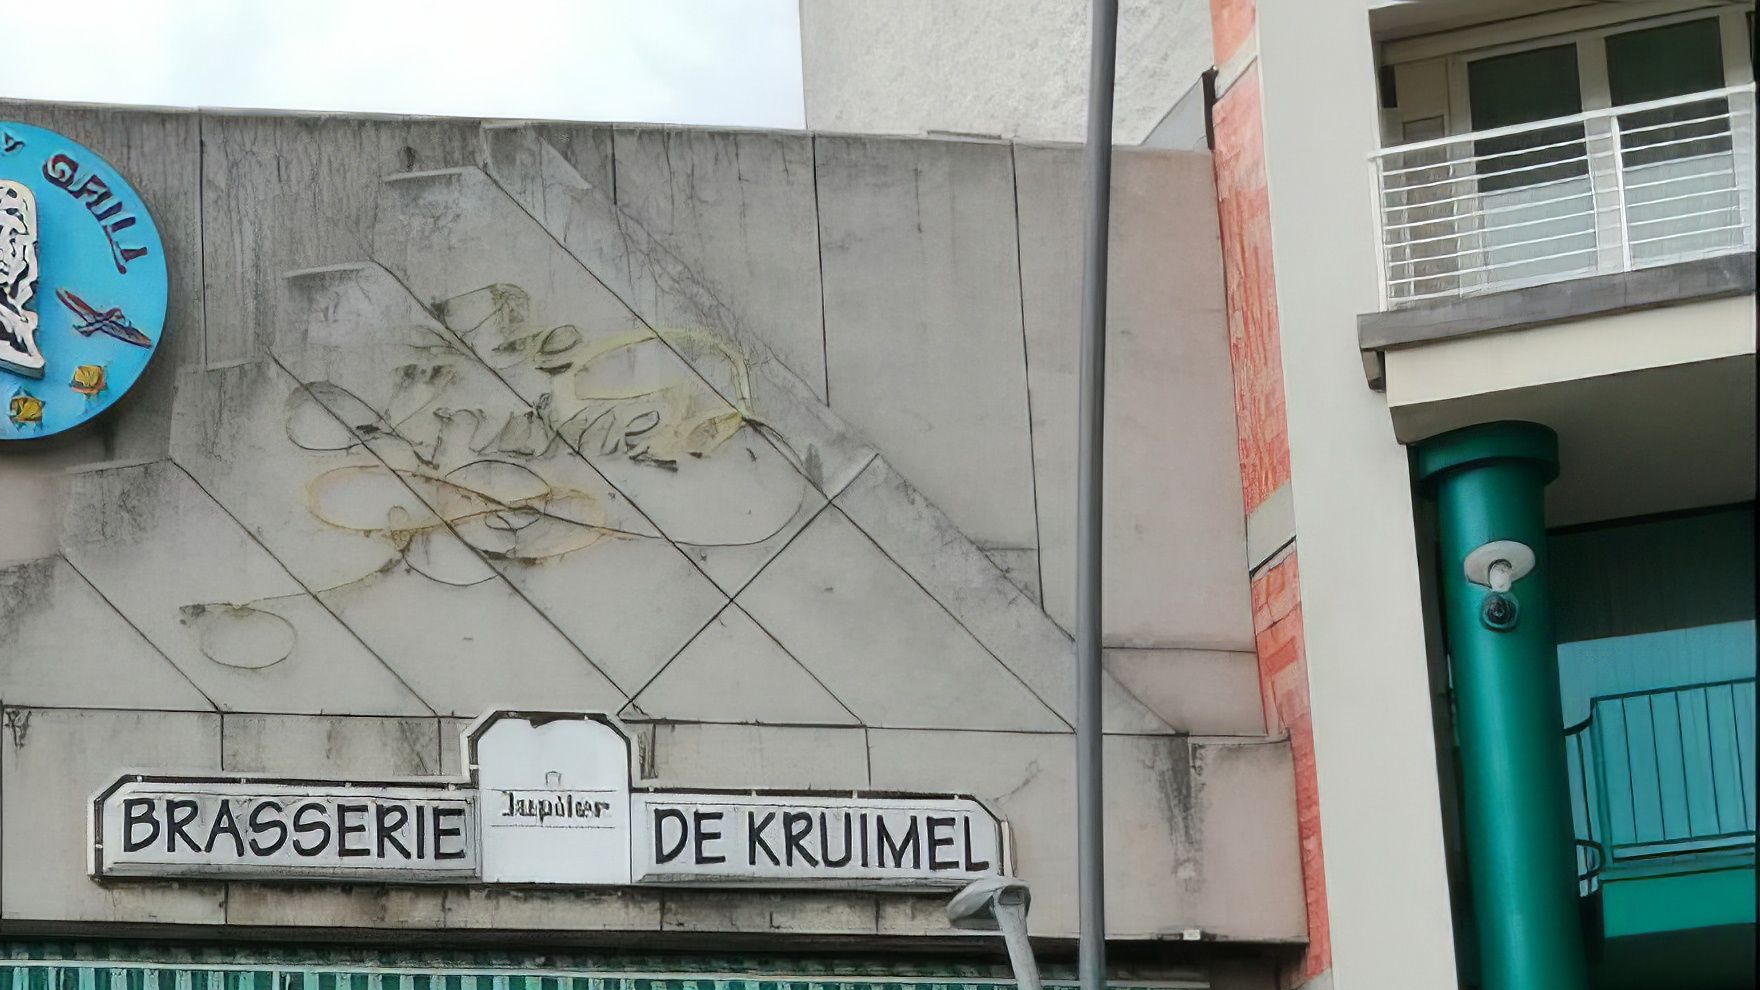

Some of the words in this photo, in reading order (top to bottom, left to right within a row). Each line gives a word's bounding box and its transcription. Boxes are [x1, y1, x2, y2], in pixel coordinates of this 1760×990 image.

[42, 154, 148, 274] GRILL
[123, 798, 465, 860] BRASSERIE
[654, 808, 726, 864] DE
[747, 812, 990, 871] KRUIMEL
